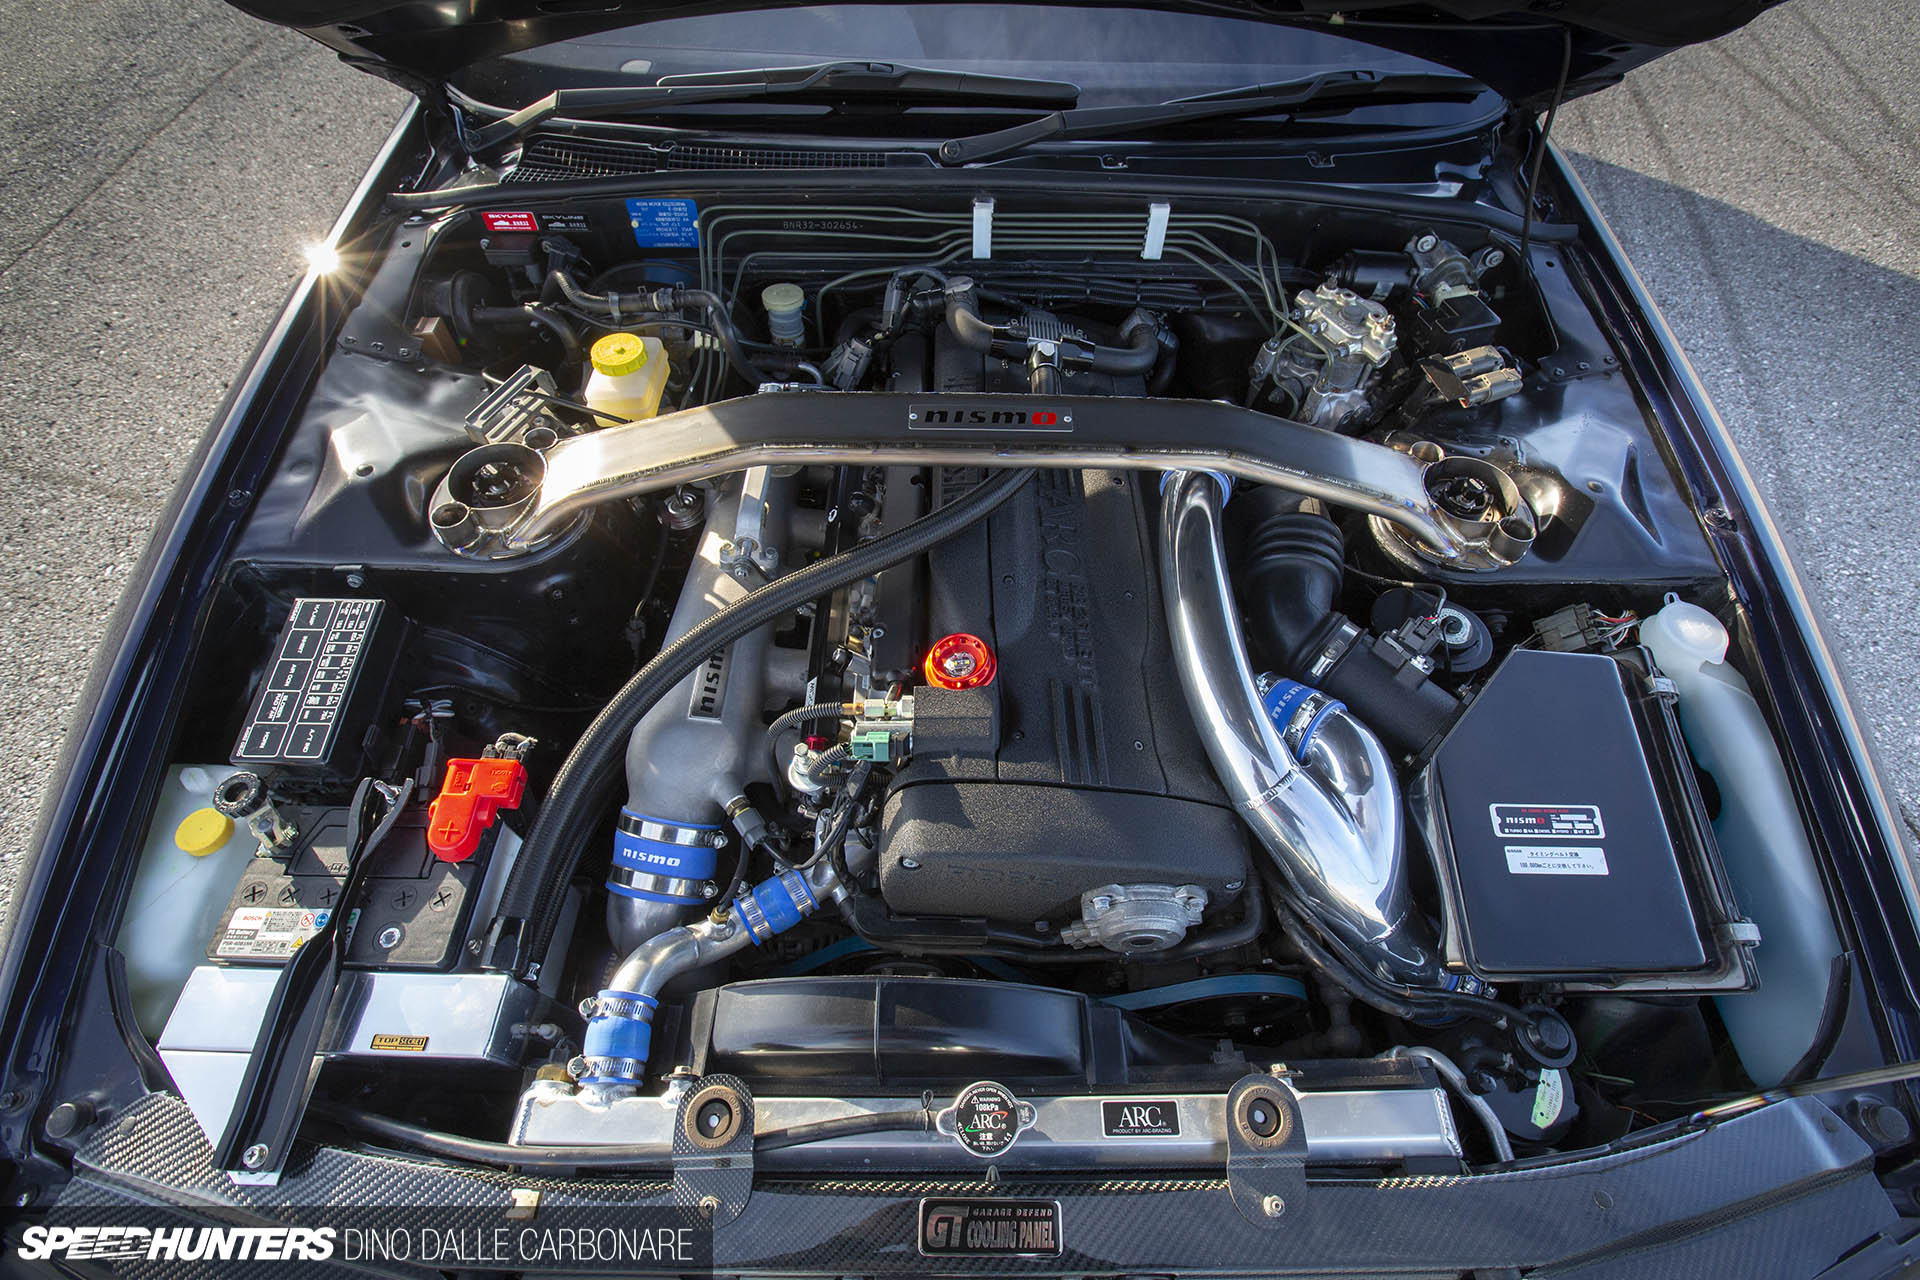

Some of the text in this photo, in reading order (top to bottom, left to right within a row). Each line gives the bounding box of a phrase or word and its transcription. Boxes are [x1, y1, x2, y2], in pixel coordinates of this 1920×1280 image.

[924, 410, 1057, 425] nismo
[701, 649, 724, 713] nism
[1505, 816, 1545, 824] nismo
[622, 847, 681, 867] nismo
[970, 1113, 1001, 1129] ARC
[1119, 1106, 1162, 1127] ARC
[958, 1127, 971, 1144] CLOSE
[972, 1208, 1053, 1217] GARAGE DEFEND
[967, 1220, 1055, 1249] COOLING PANEL
